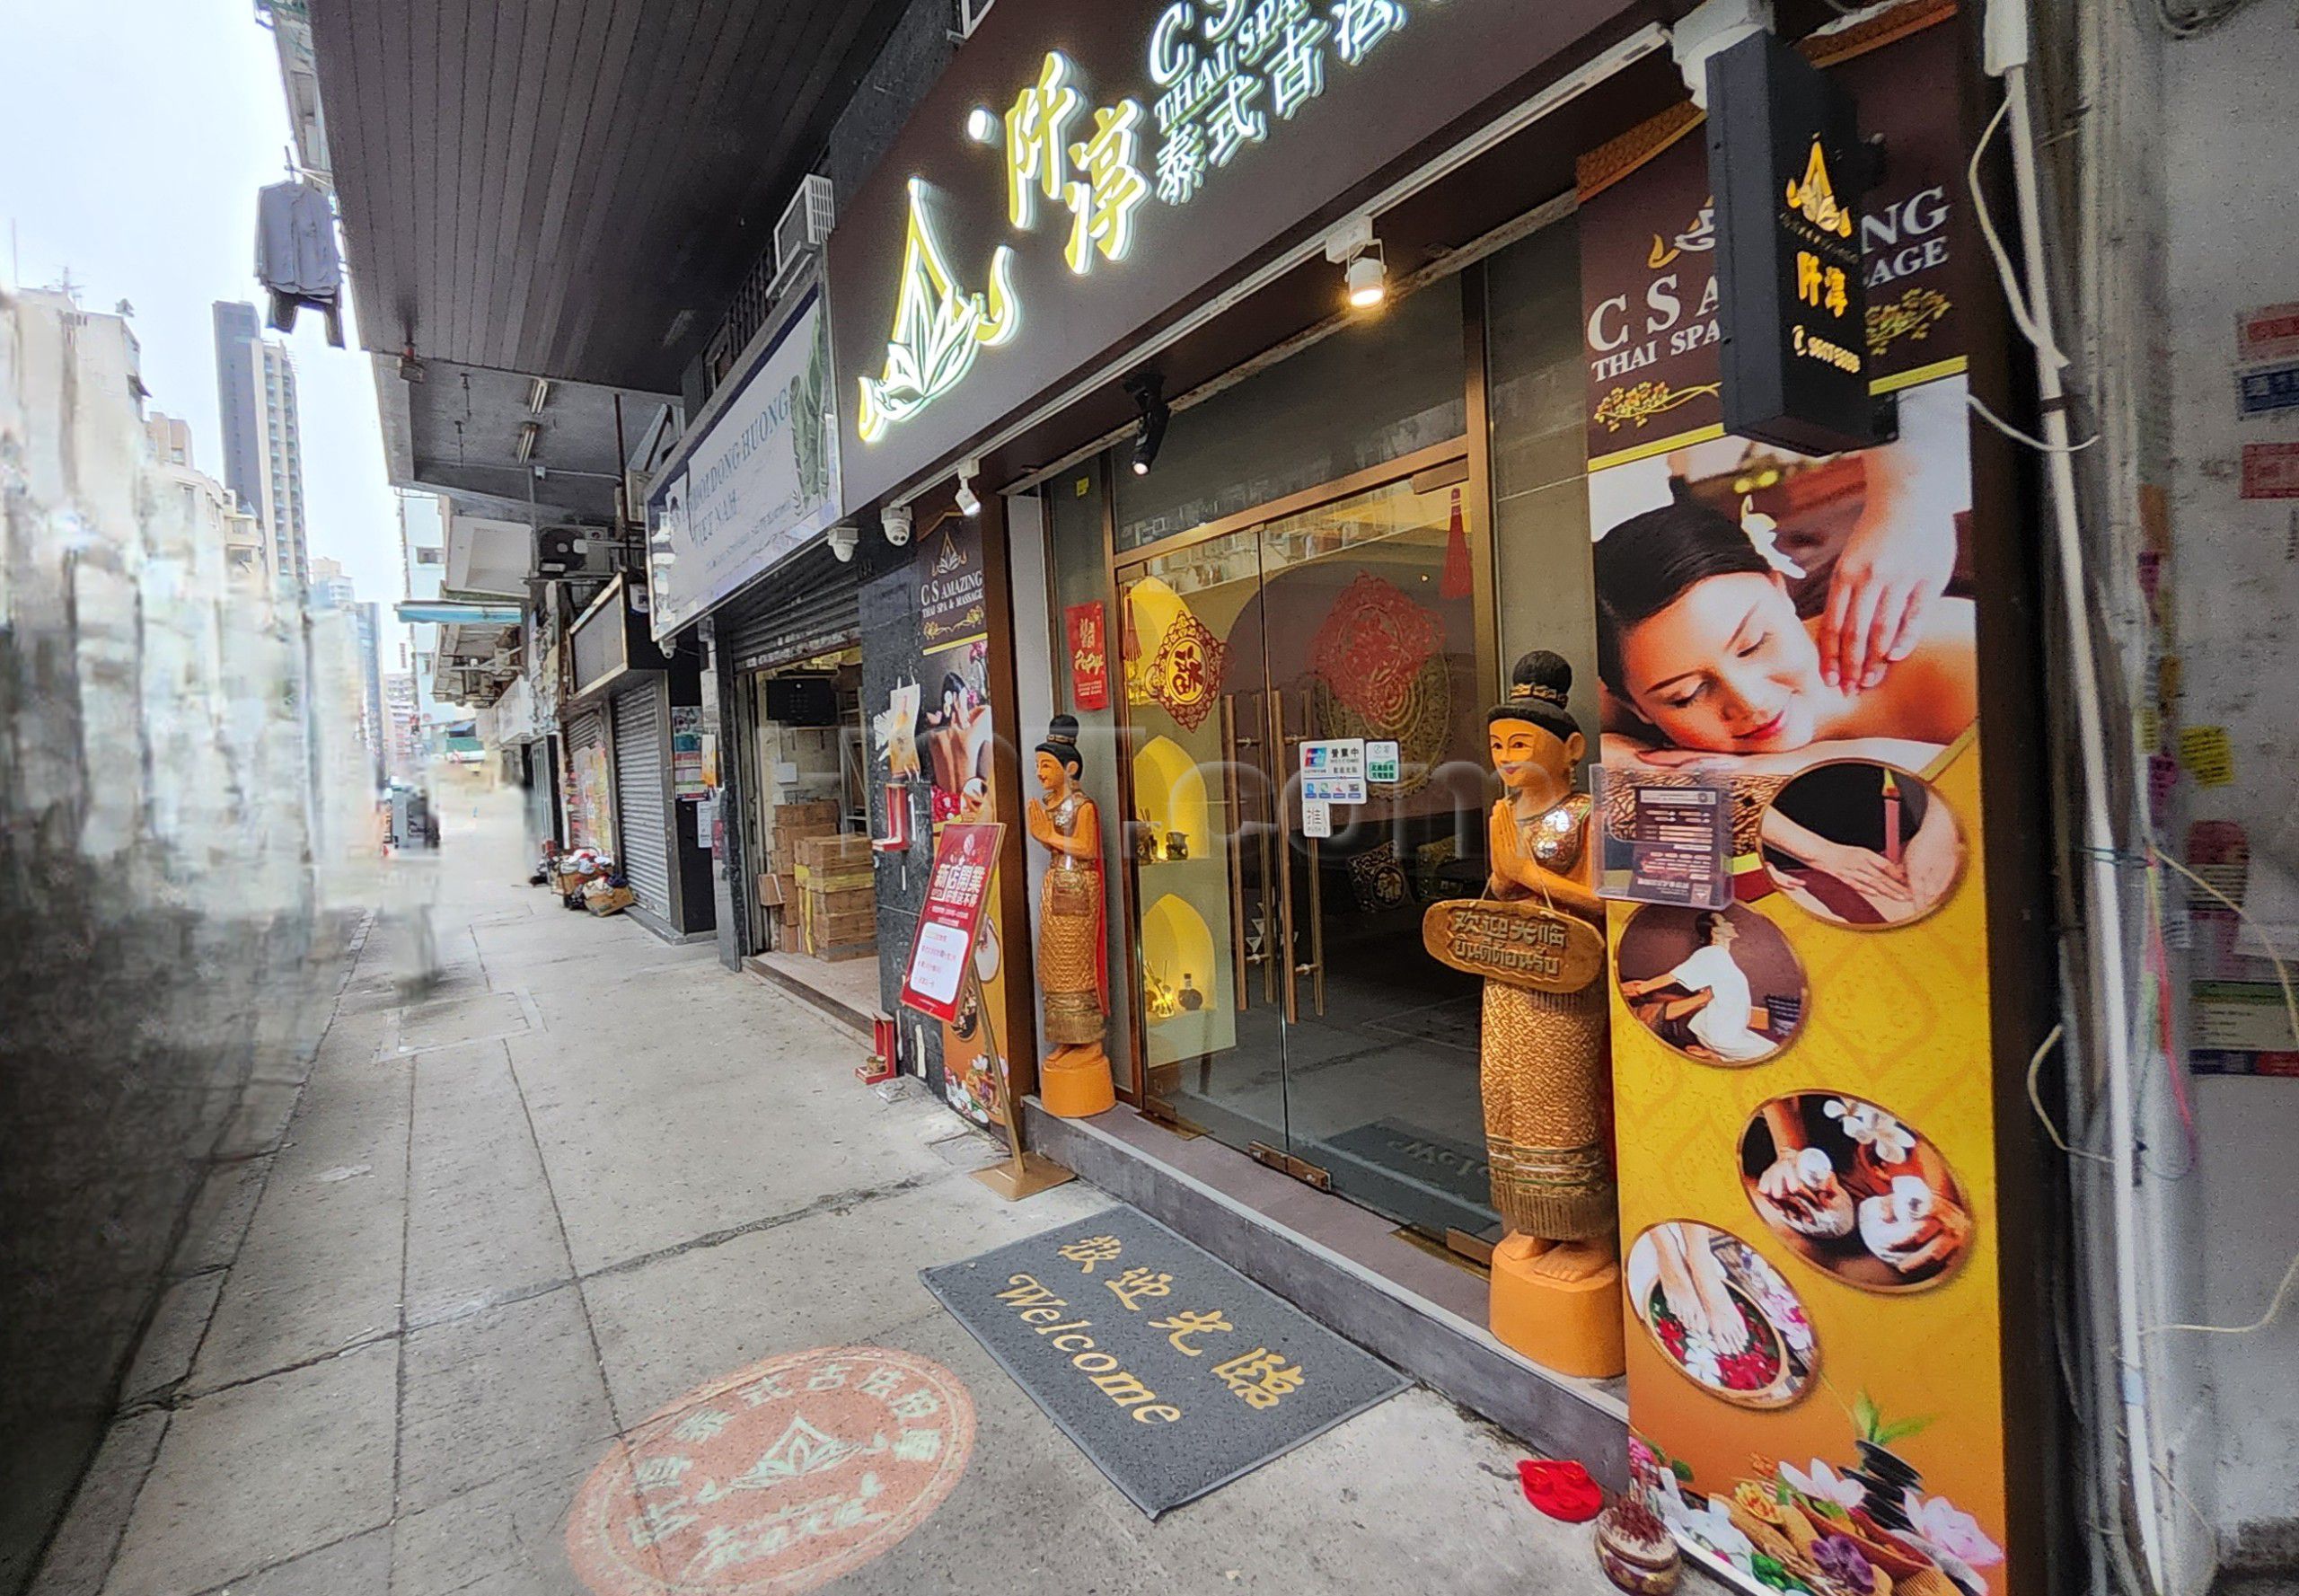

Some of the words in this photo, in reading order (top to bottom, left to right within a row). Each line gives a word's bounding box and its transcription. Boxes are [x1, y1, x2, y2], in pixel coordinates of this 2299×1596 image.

[1154, 40, 1236, 134] THAI
[1591, 340, 1658, 384] THAI
[1670, 318, 1721, 357] SPA
[741, 386, 789, 464] HUONG
[940, 569, 983, 600] AMAZING
[994, 1273, 1182, 1424] Welcome
